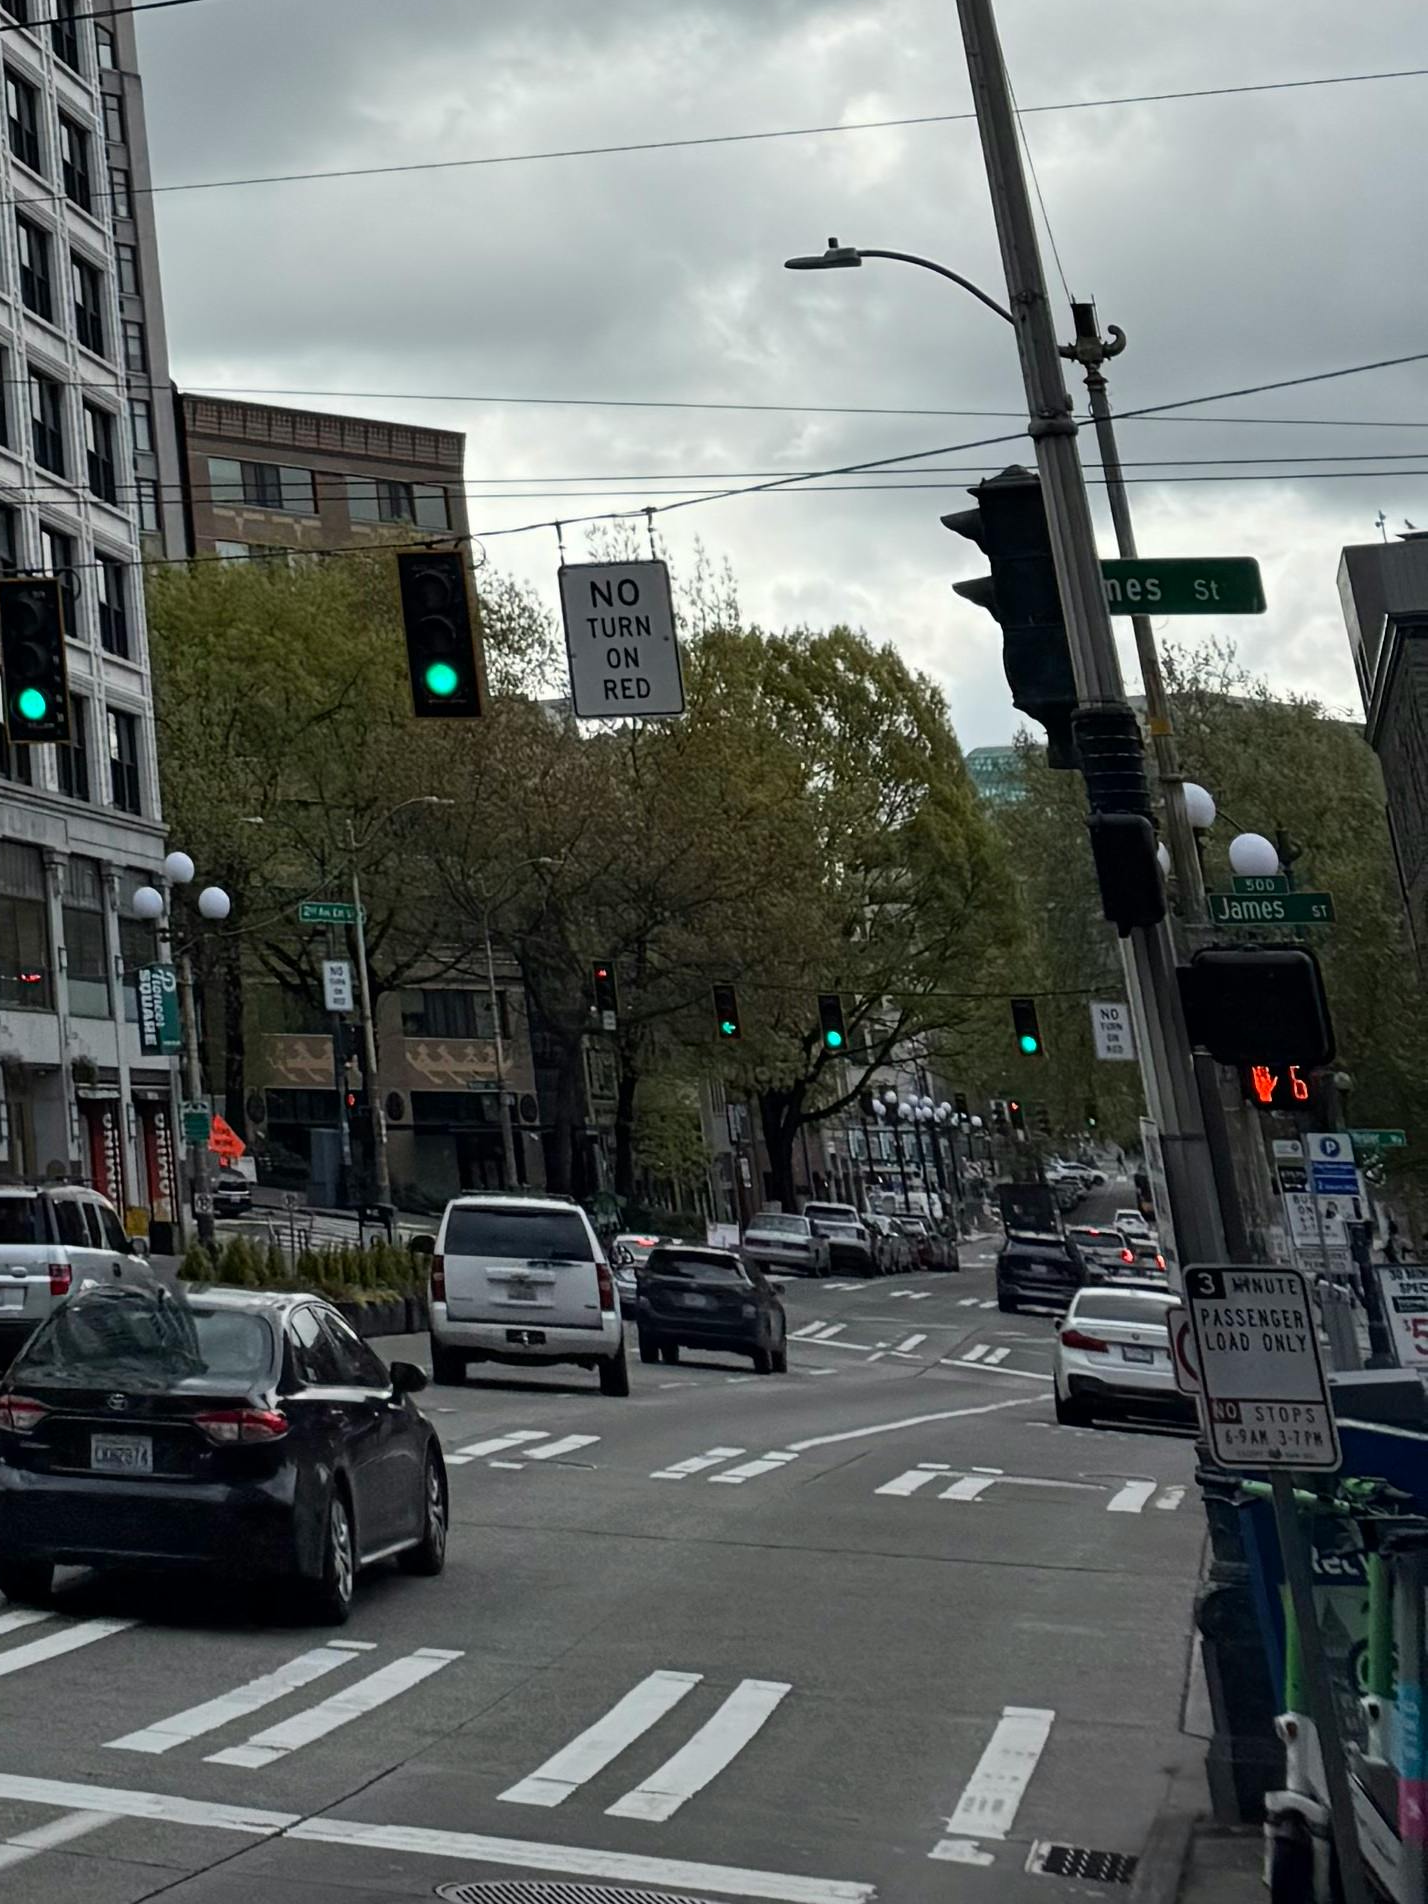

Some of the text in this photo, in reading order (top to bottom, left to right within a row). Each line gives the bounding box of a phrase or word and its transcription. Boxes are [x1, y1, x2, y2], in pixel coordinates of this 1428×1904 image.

[589, 578, 640, 609] NO
[1102, 577, 1220, 602] mes St
[586, 615, 652, 639] TURN
[606, 646, 640, 670] ON
[603, 677, 652, 701] RED
[1245, 878, 1275, 891] 500
[1219, 896, 1327, 920] James ST
[1099, 1007, 1119, 1021] NO
[1289, 1065, 1309, 1100] 6
[1197, 1272, 1297, 1295] 3 MINUTE
[1201, 1307, 1305, 1329] PASSENGER
[1204, 1332, 1308, 1353] LOAD ONLY
[1213, 1402, 1316, 1424] NO STOPS
